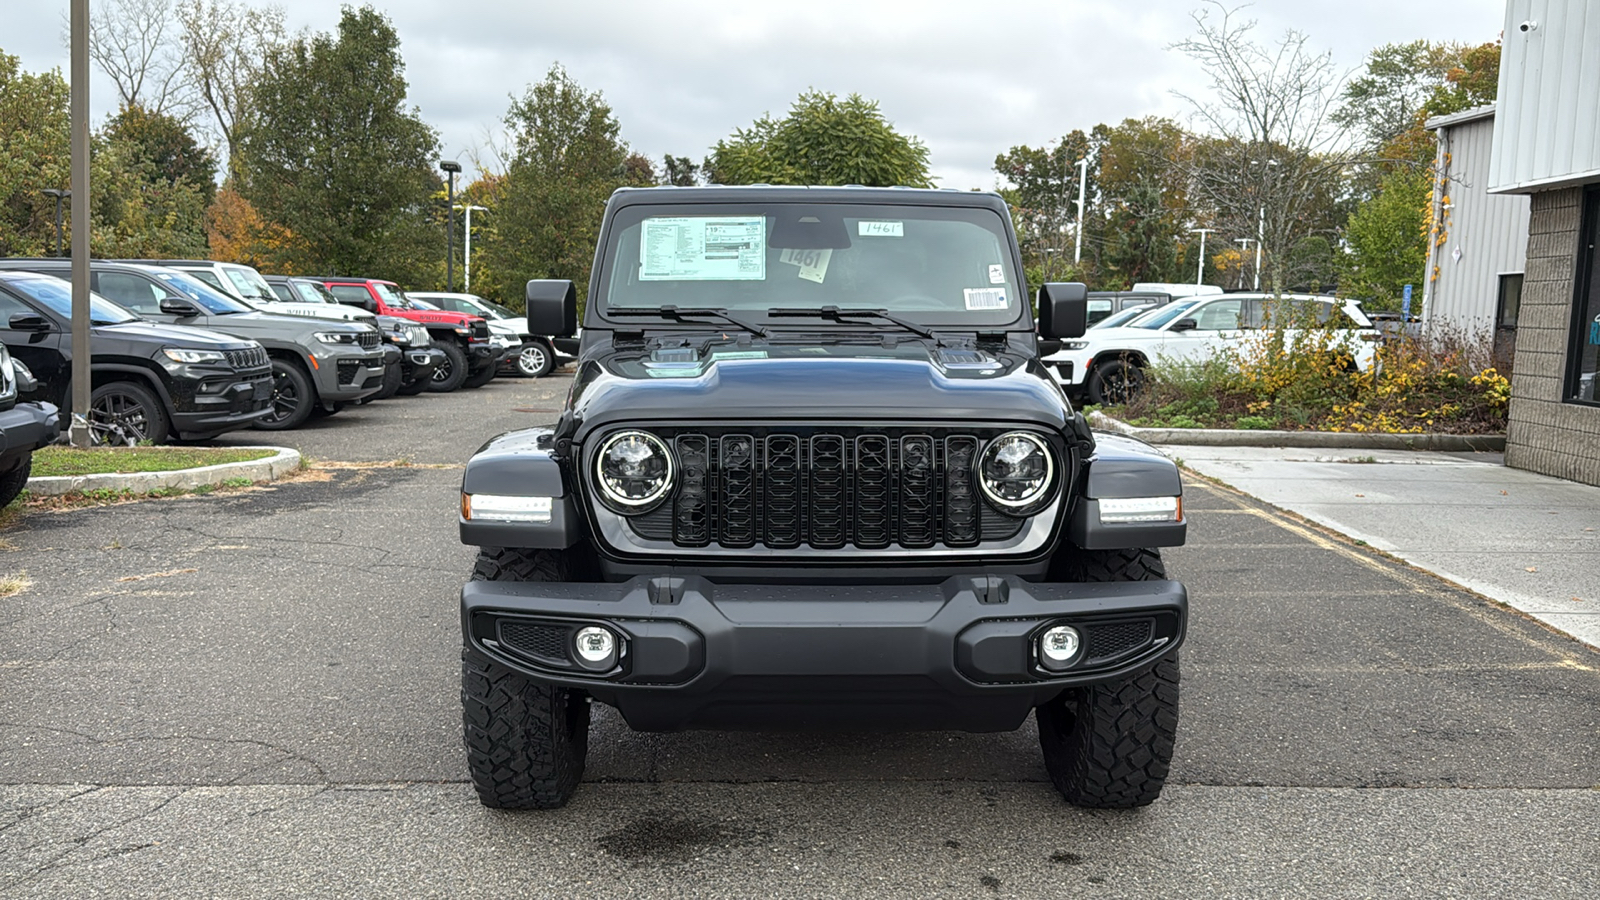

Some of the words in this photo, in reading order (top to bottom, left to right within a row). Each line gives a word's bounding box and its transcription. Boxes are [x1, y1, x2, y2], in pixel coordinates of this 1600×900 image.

[867, 222, 895, 233] 1461
[788, 250, 822, 269] 1461
[1589, 321, 1600, 345] R
